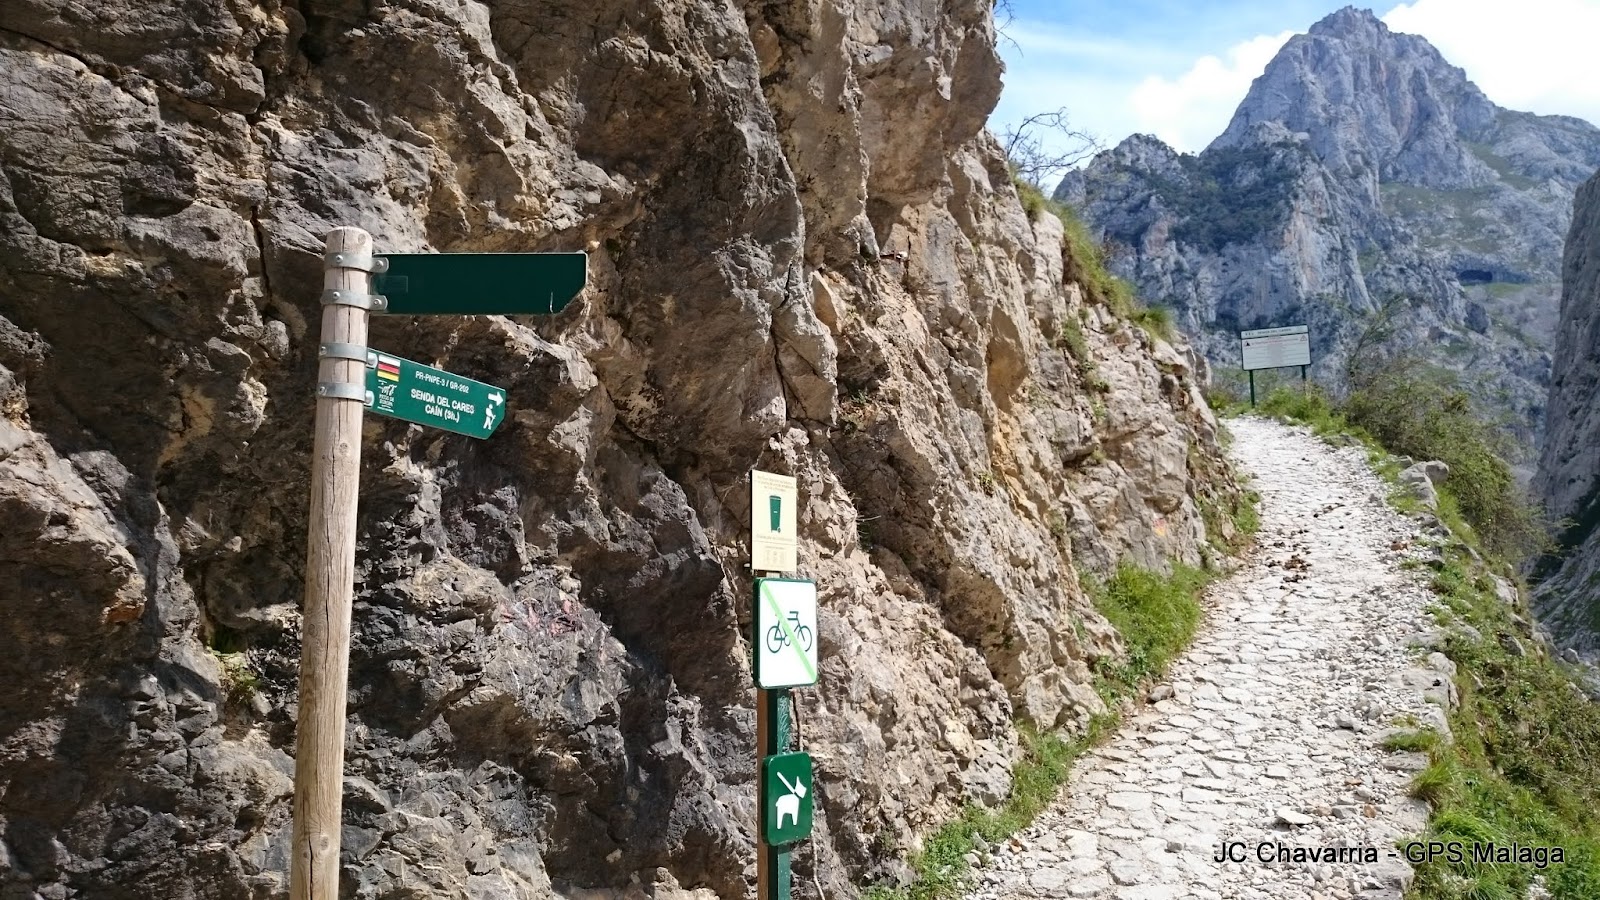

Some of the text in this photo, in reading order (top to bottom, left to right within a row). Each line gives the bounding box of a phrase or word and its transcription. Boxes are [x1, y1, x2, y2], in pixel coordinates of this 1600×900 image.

[449, 380, 469, 393] GR-202
[410, 388, 435, 403] SENDA
[437, 395, 450, 407] DEL
[452, 400, 475, 415] CARES
[425, 404, 443, 417] CAÍN
